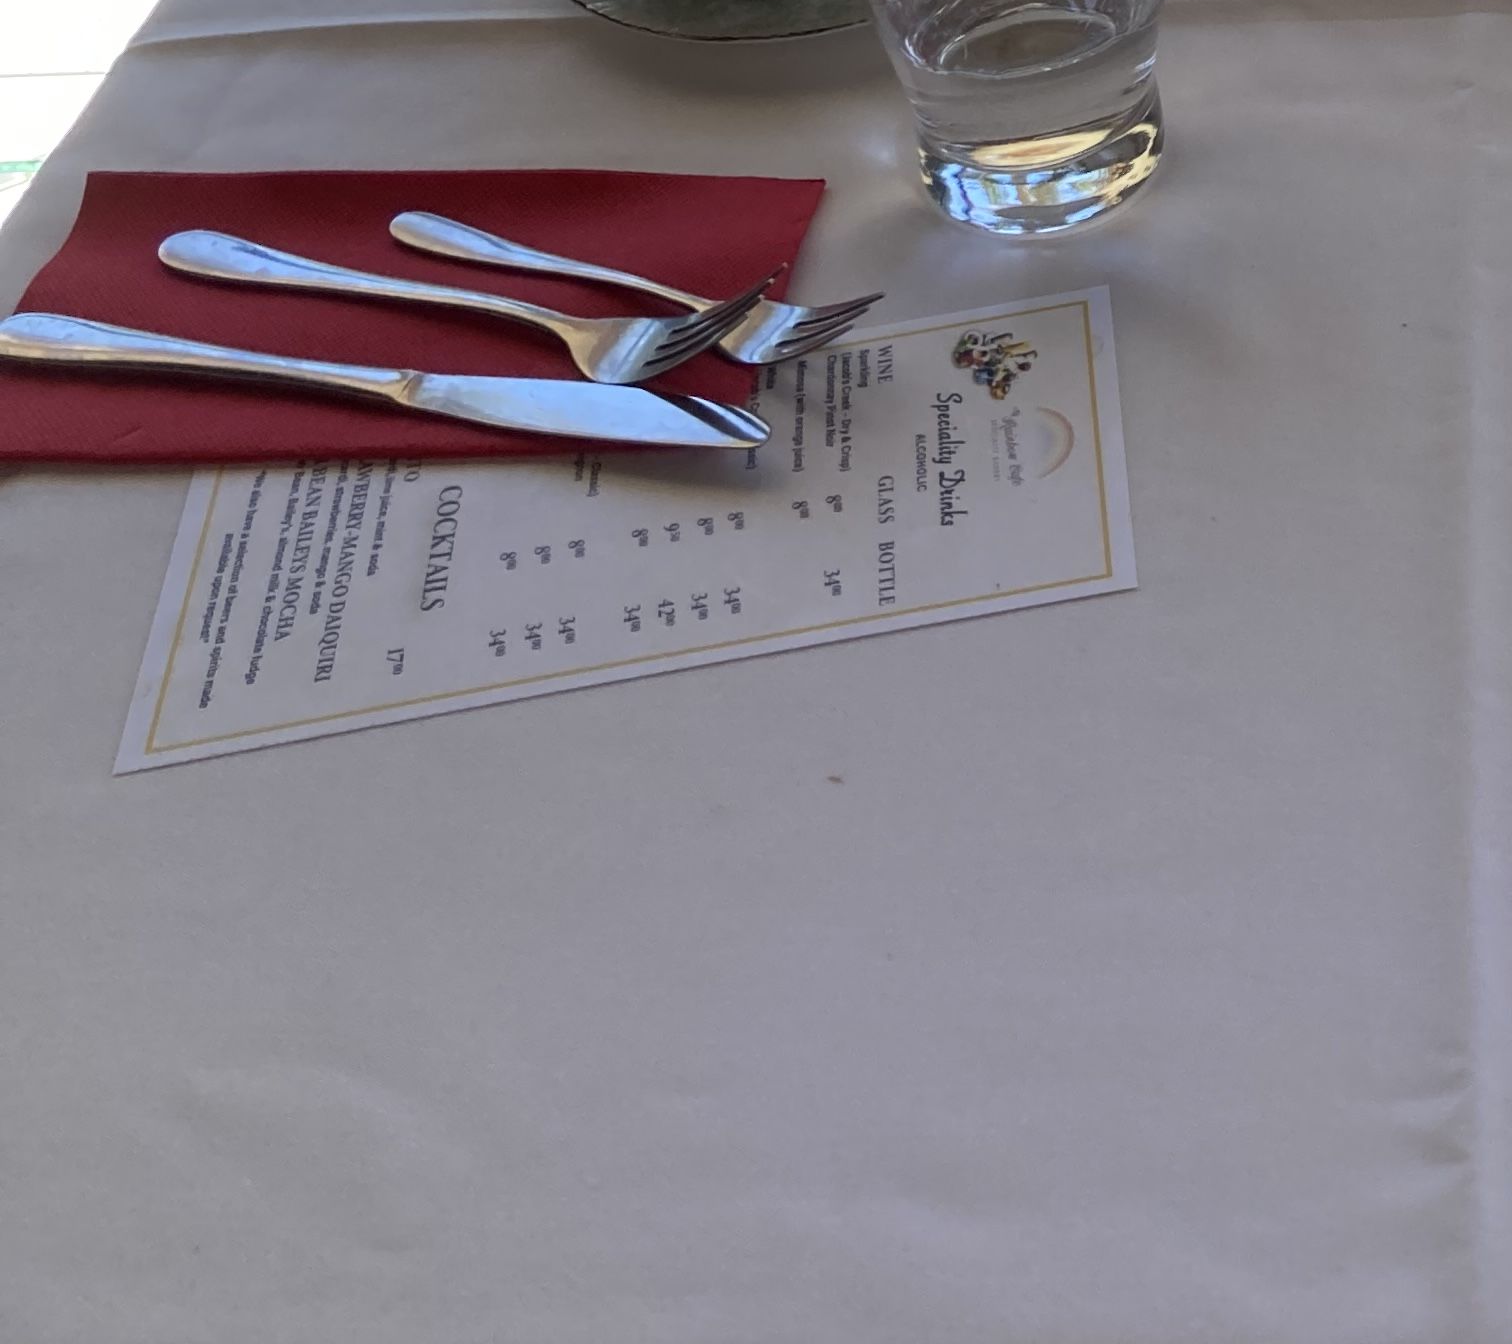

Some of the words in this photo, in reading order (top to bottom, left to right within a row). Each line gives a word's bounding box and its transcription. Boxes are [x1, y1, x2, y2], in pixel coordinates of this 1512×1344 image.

[877, 345, 893, 384] WINE
[931, 393, 966, 464] Speciality
[999, 416, 1019, 460] Rainbow
[304, 468, 327, 508] BEAN
[915, 434, 928, 492] ALCOHOLIC
[878, 475, 895, 524] GLASS
[939, 469, 968, 526] Drinks
[290, 511, 319, 574] BAILEYS
[332, 462, 374, 598] AWBERRY-MANGO
[420, 485, 463, 612] COCKTAILS
[367, 552, 380, 576] soda
[878, 541, 895, 606] BOTTLE
[252, 606, 273, 654] chocolate
[274, 576, 304, 642] MOCHA
[245, 655, 264, 685] fudge
[314, 600, 347, 683] DAIQUIRI
[199, 679, 215, 709] made
